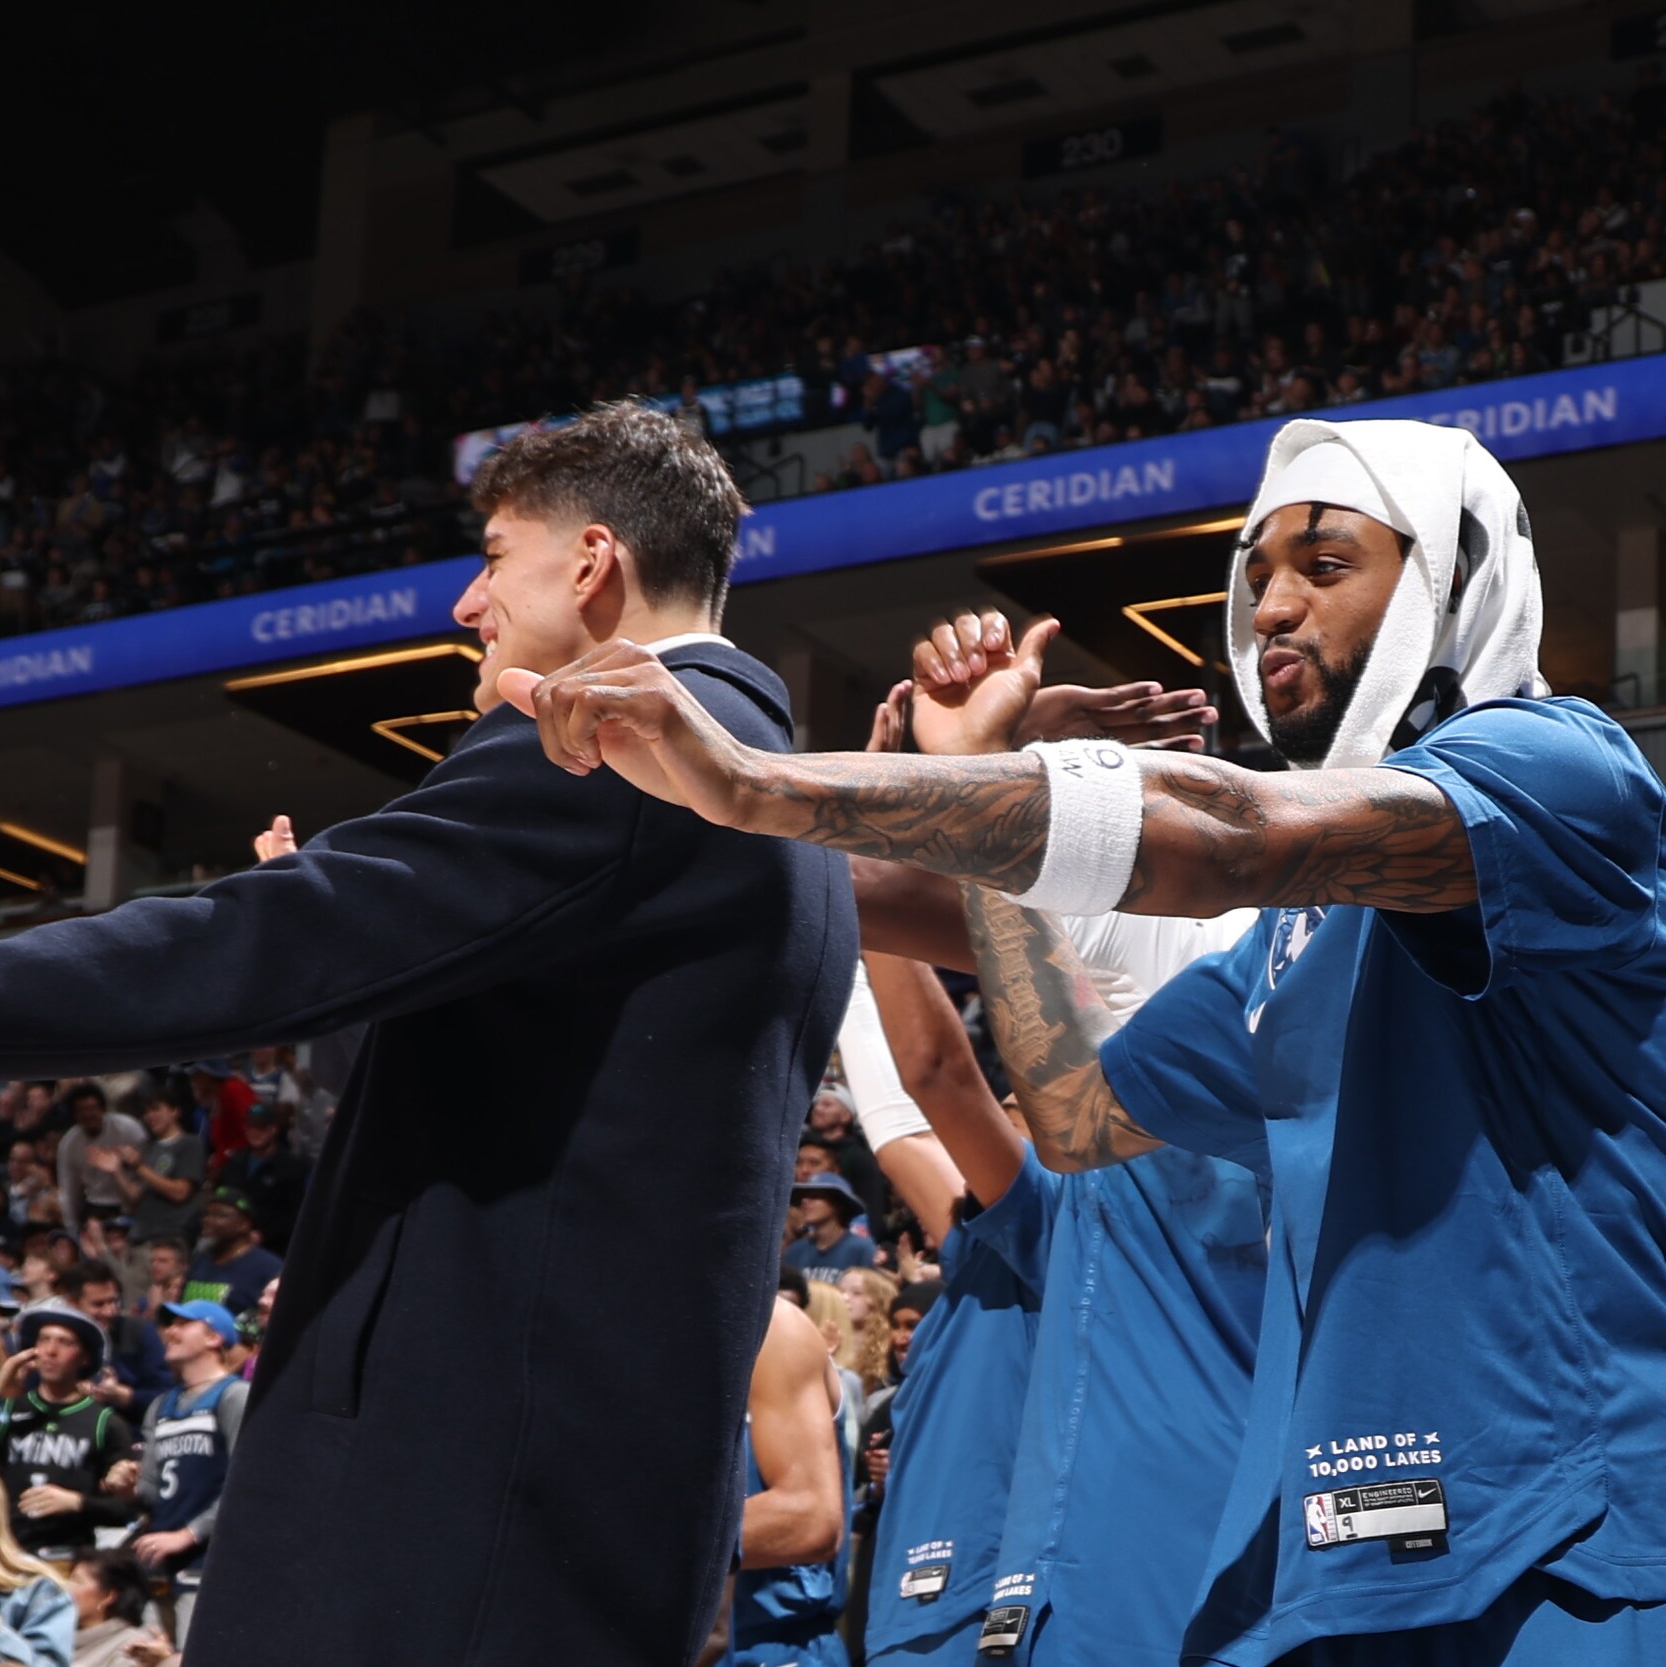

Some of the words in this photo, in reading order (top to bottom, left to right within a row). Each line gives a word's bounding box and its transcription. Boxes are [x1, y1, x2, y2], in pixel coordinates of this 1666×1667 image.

[1062, 127, 1123, 169] 230
[1429, 387, 1617, 440] RIDIAN
[975, 461, 1173, 520] CERIDIAN
[250, 588, 418, 645] CERIDIAN
[1331, 1435, 1388, 1454] LAND
[1394, 1433, 1416, 1448] OF
[160, 1459, 180, 1499] 5
[1309, 1455, 1378, 1478] 10,000
[1385, 1450, 1442, 1467] LAKES
[1339, 1497, 1356, 1509] XL
[1362, 1487, 1412, 1500] ENGINEERED
[926, 1549, 952, 1560] LAKES
